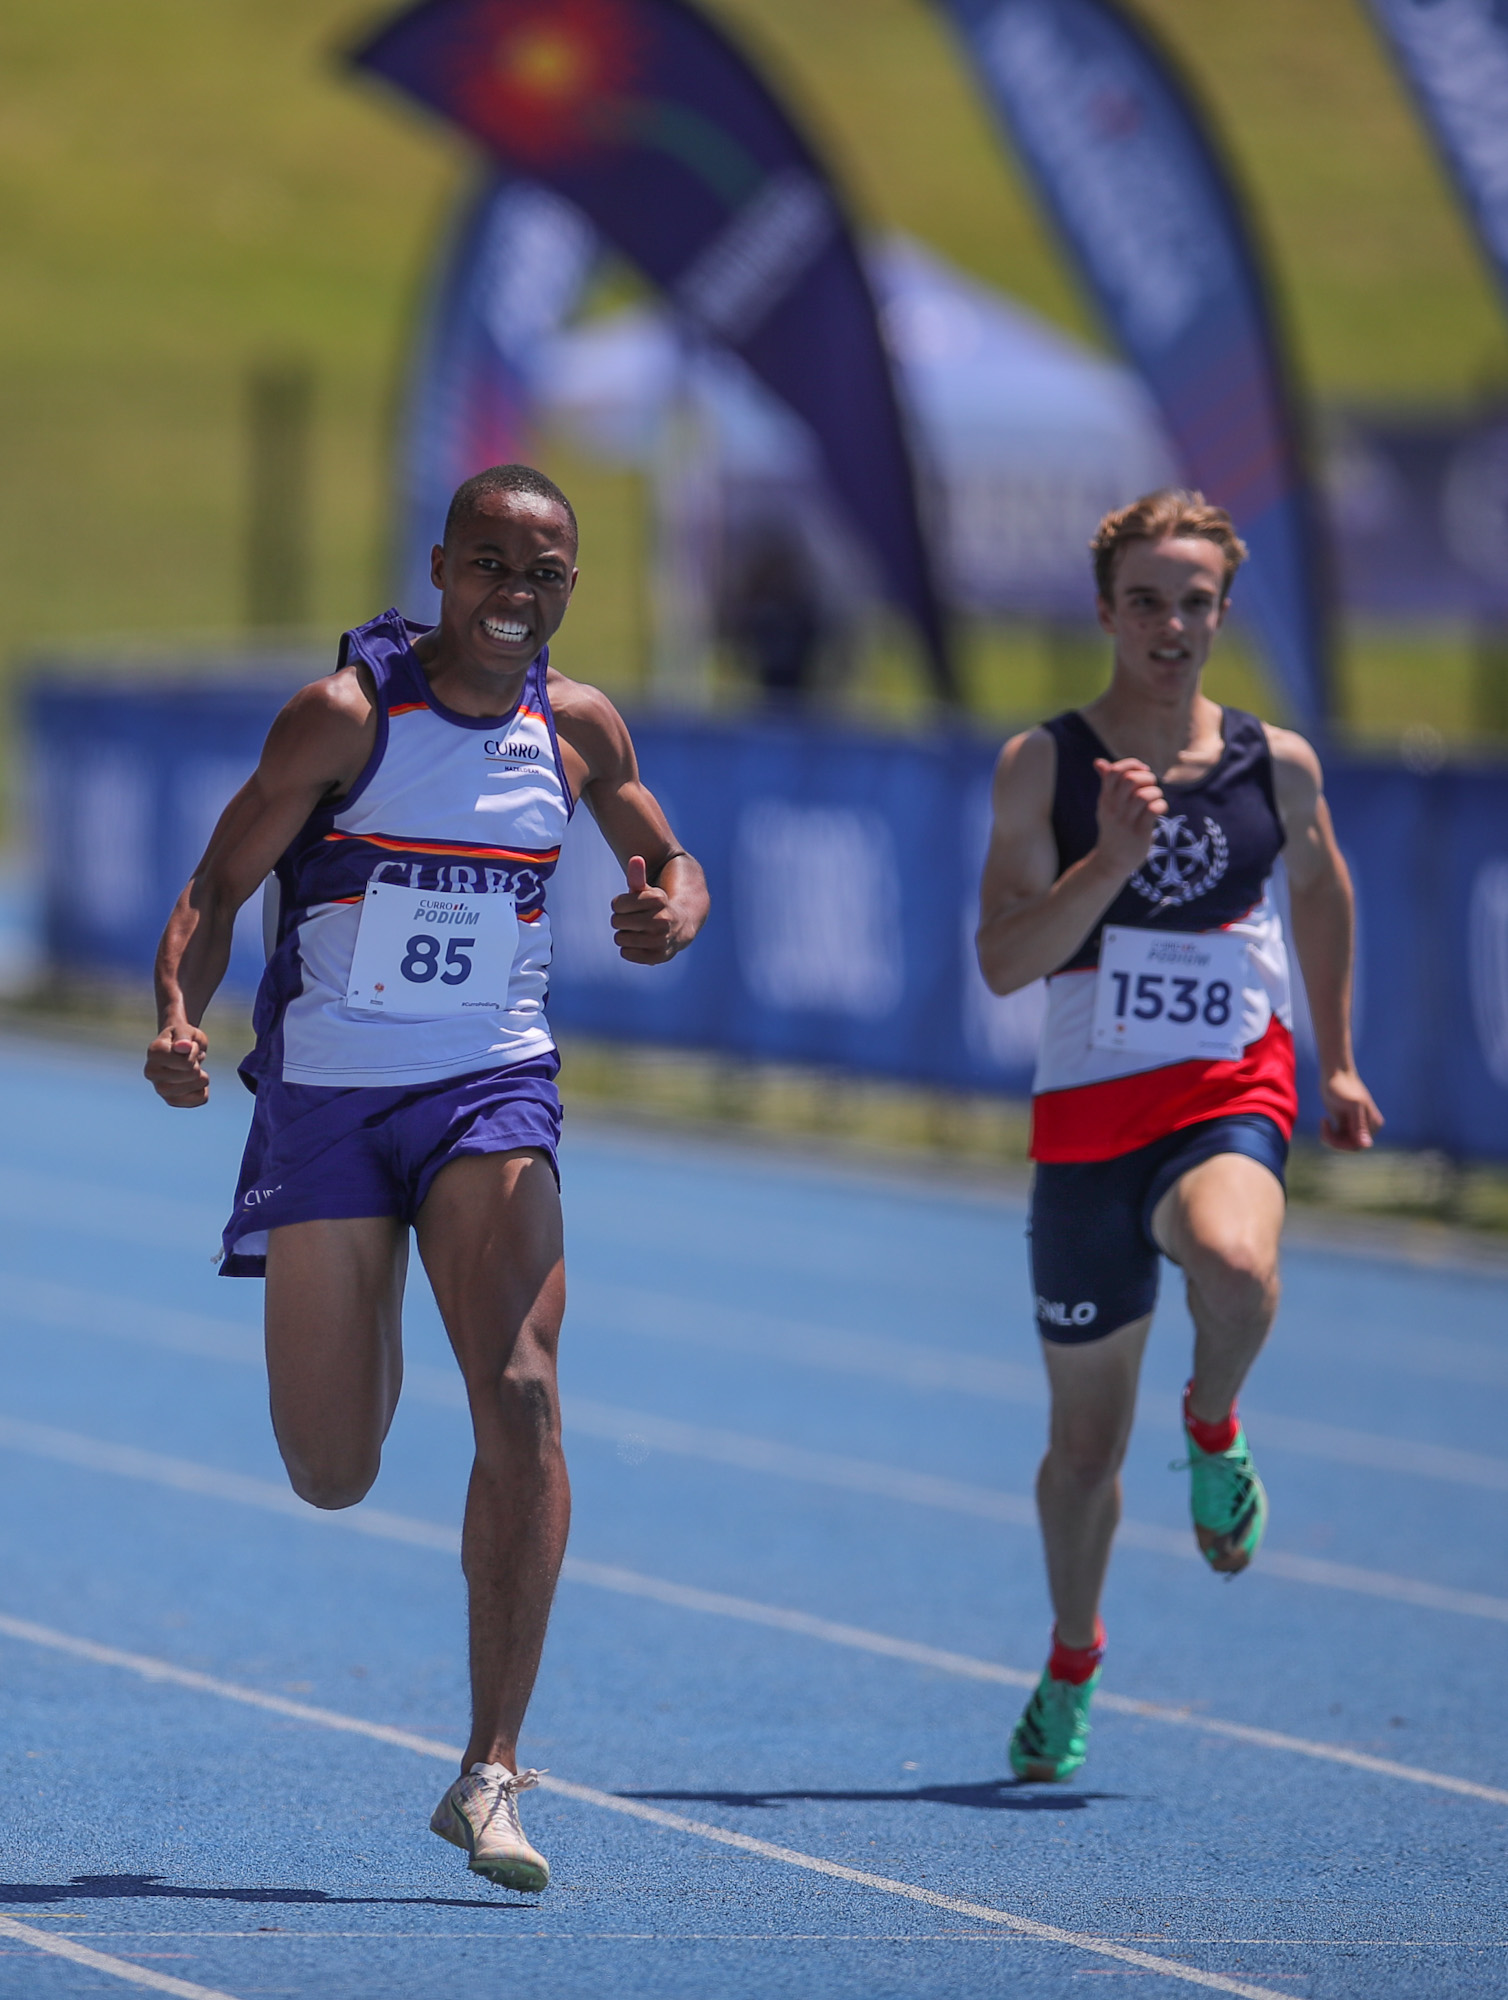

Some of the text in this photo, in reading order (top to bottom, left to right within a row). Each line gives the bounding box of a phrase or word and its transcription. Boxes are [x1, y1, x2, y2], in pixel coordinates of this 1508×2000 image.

[484, 740, 540, 760] CURRO
[369, 860, 541, 903] CURRO
[413, 908, 480, 925] PODIUM
[419, 899, 453, 911] CURRO
[400, 934, 476, 986] 85
[1111, 972, 1232, 1027] 1538
